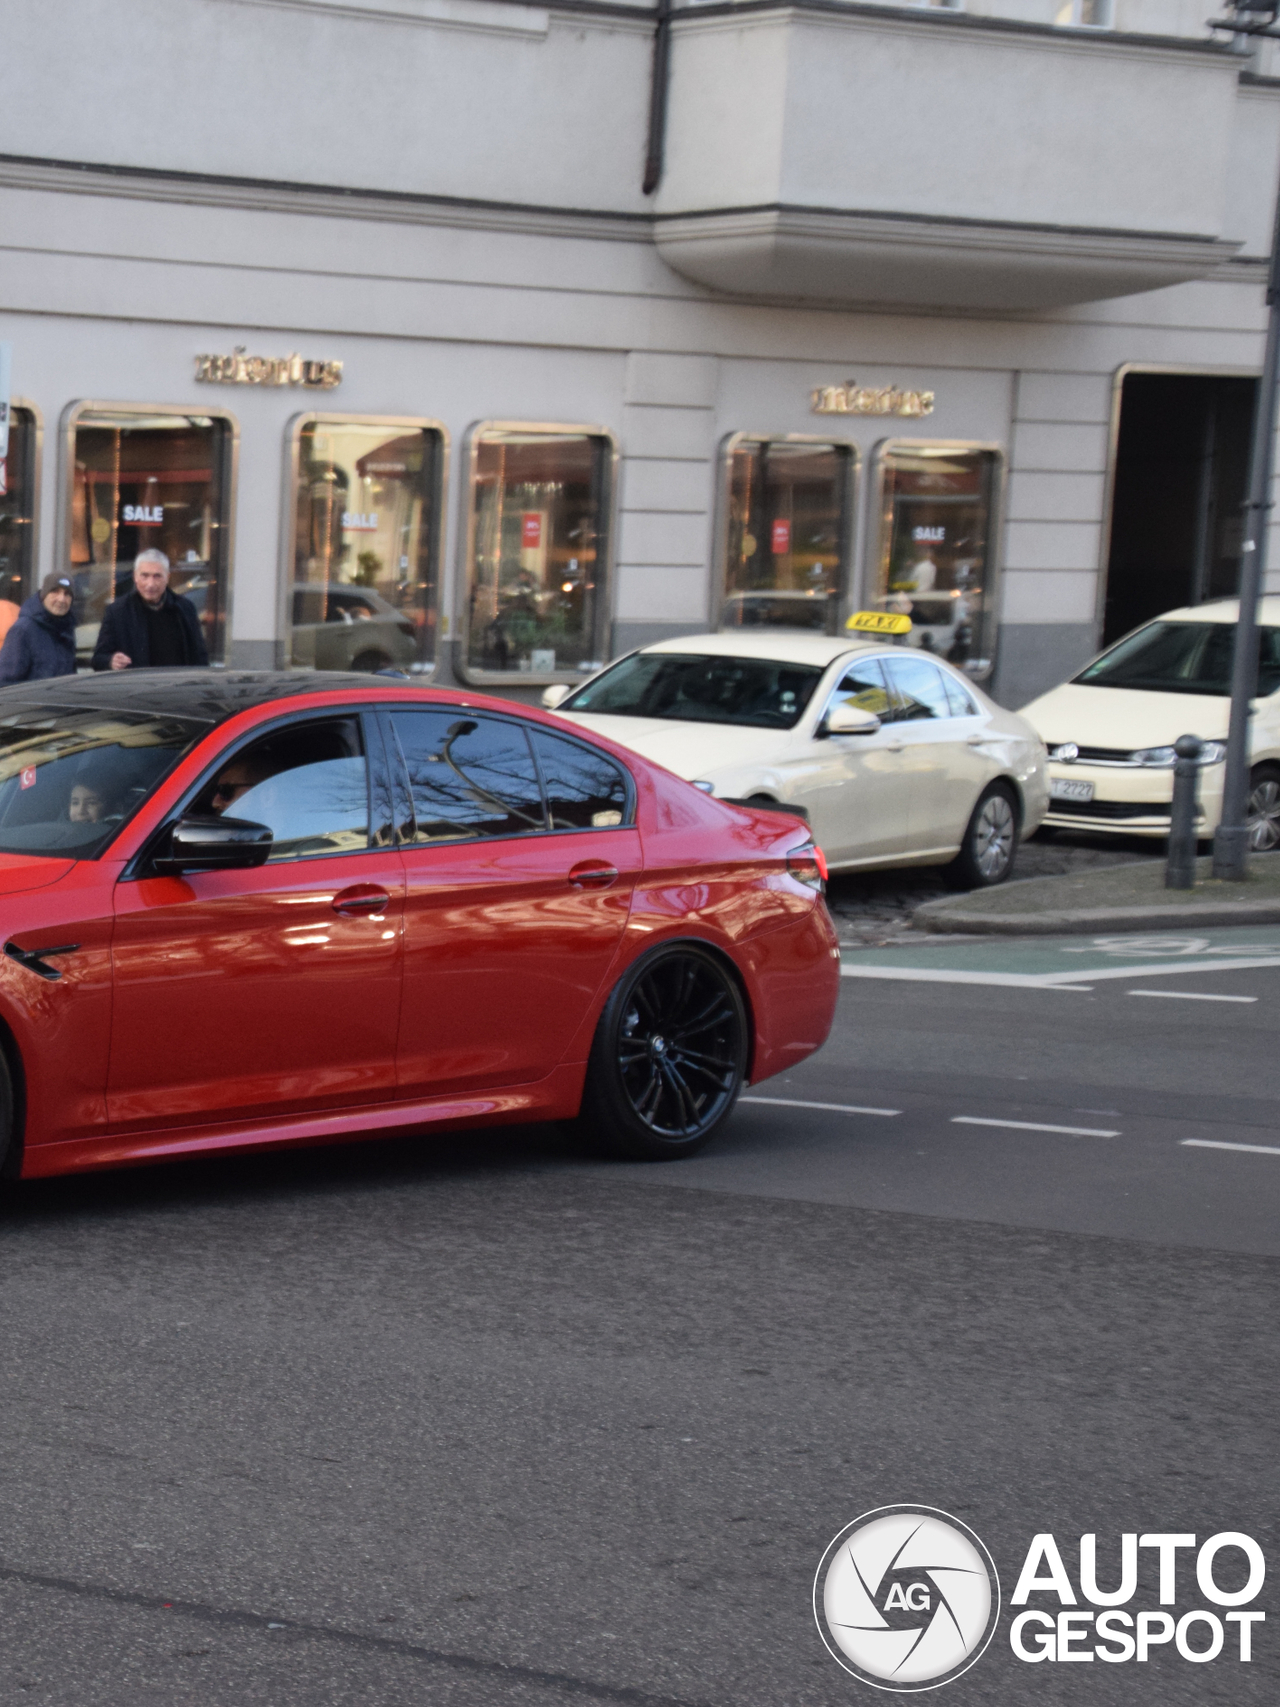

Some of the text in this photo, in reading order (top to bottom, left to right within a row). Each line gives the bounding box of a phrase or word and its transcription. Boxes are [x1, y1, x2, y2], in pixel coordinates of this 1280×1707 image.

[124, 505, 163, 522] SALE
[341, 512, 378, 528] SALE
[915, 526, 945, 540] SALE
[856, 615, 900, 629] TAXI
[1063, 782, 1093, 796] 2727
